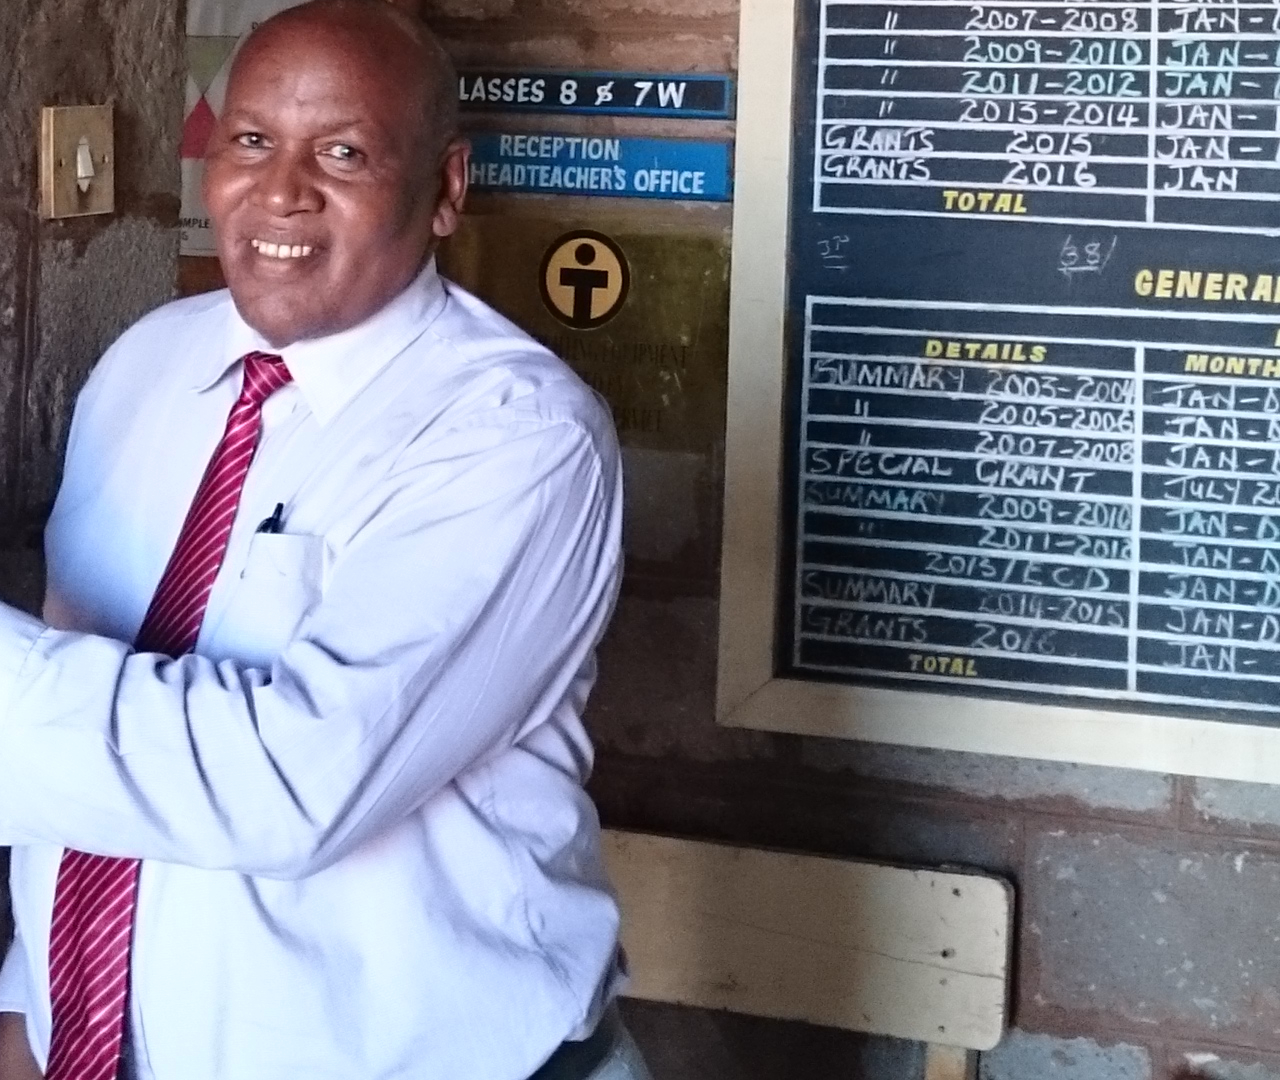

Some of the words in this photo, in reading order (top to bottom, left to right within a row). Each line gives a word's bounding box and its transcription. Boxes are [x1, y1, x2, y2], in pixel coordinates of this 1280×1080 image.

[459, 76, 545, 102] LASSES
[560, 79, 578, 105] 8
[499, 135, 621, 161] RECEPTION
[825, 125, 934, 152] GRANTS
[1006, 129, 1092, 155] 2015
[471, 163, 626, 190] HEADTEACHER'S
[634, 170, 704, 194] OFFICE
[823, 155, 931, 180] GRANTS
[1003, 162, 1096, 187] 2016
[943, 191, 1027, 213] TOTAL
[925, 339, 1048, 363] DETAILS
[809, 446, 953, 477] SPECIAL
[976, 460, 1096, 493] GRANT
[909, 653, 978, 676] TOTAL
